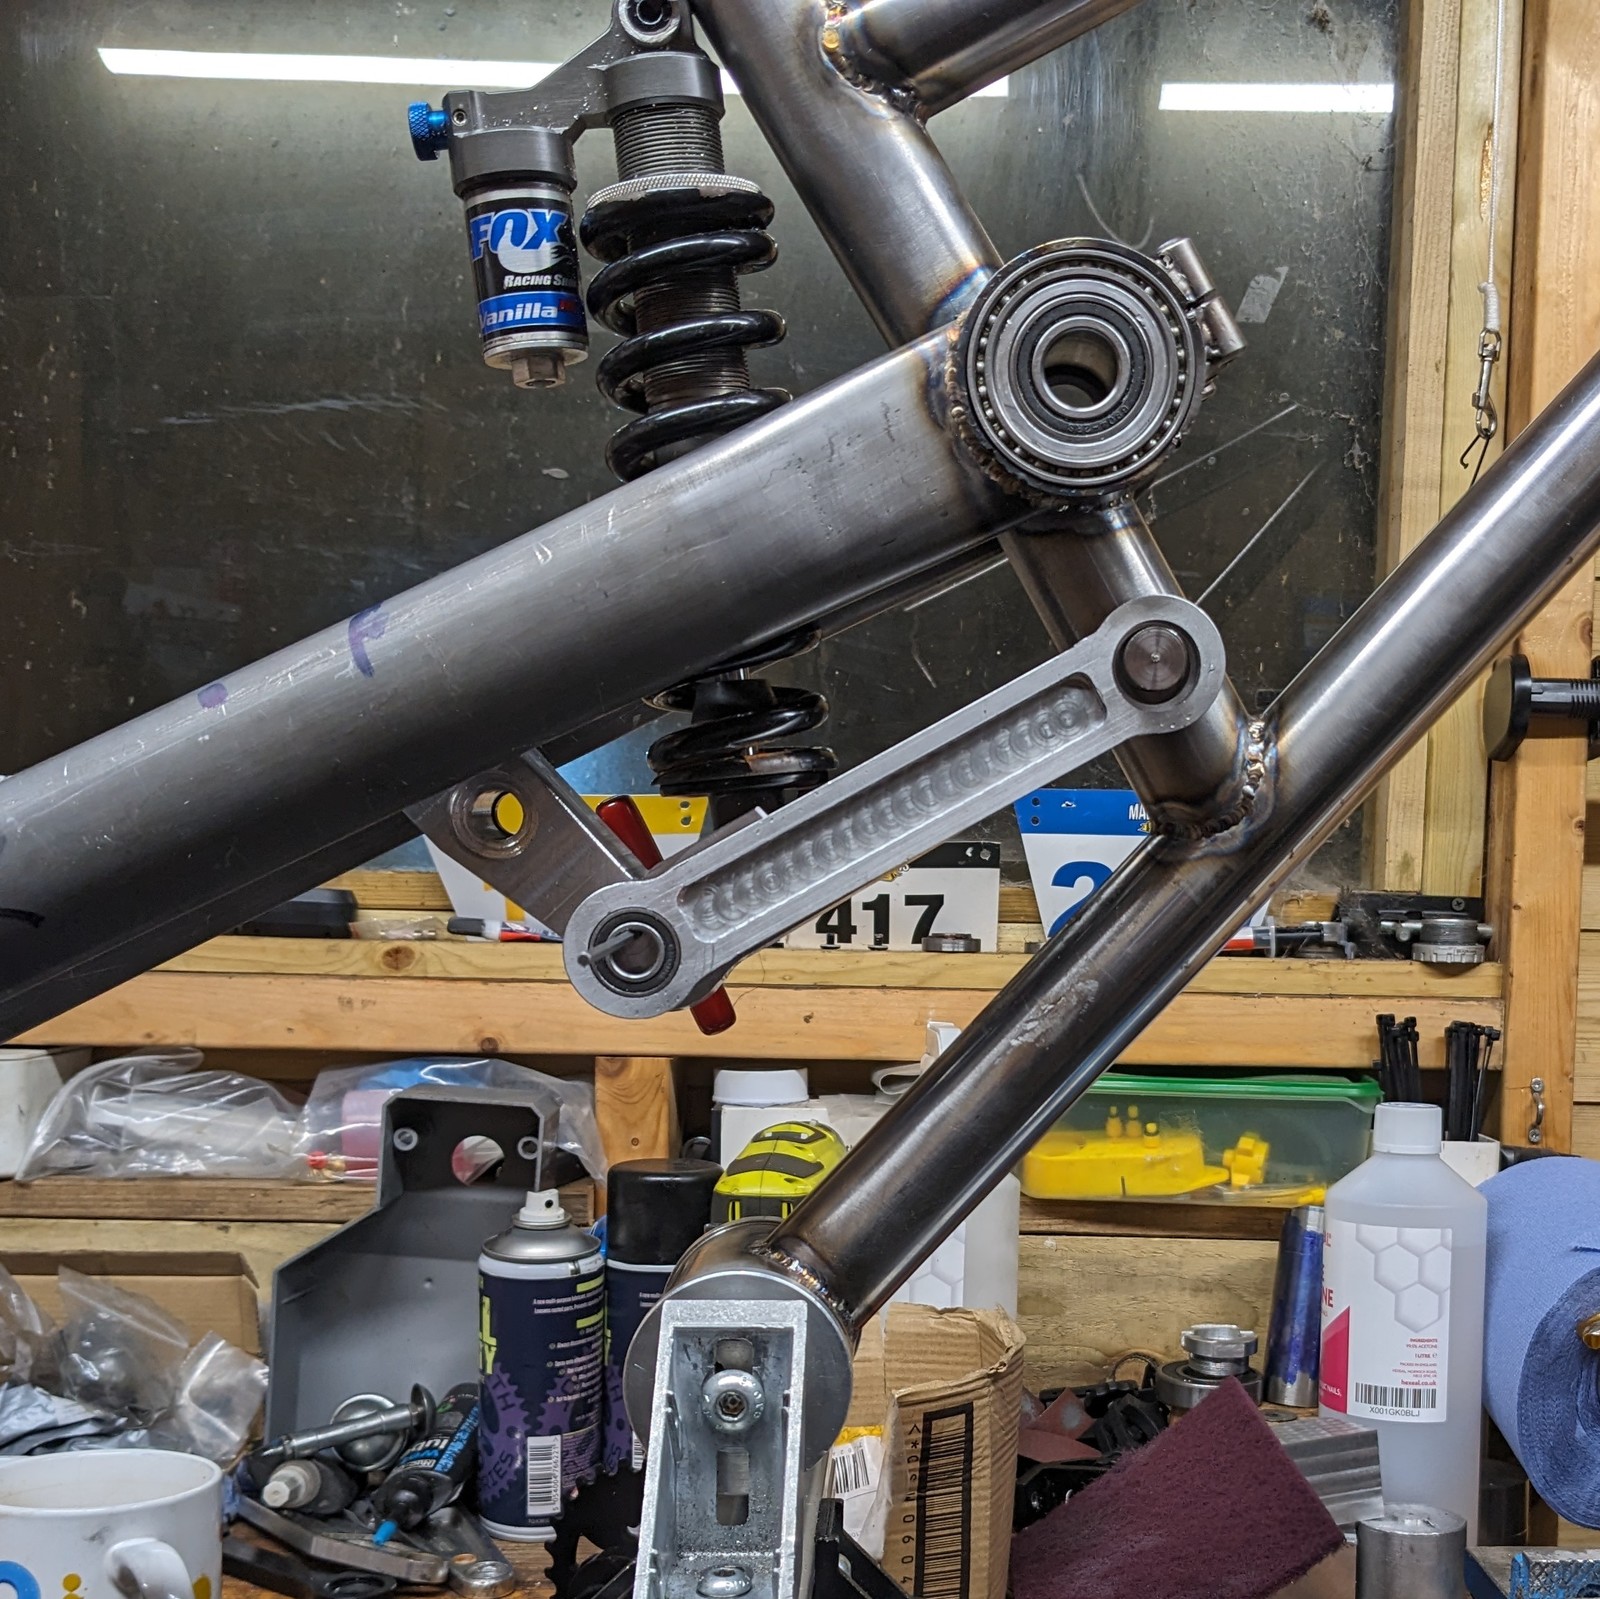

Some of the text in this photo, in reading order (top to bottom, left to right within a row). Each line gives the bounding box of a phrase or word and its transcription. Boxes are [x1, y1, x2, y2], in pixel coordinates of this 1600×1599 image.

[470, 208, 568, 262] FOX
[503, 274, 552, 290] RACING
[815, 893, 945, 945] 417
[1369, 1406, 1420, 1417] X001GK0BLJ
